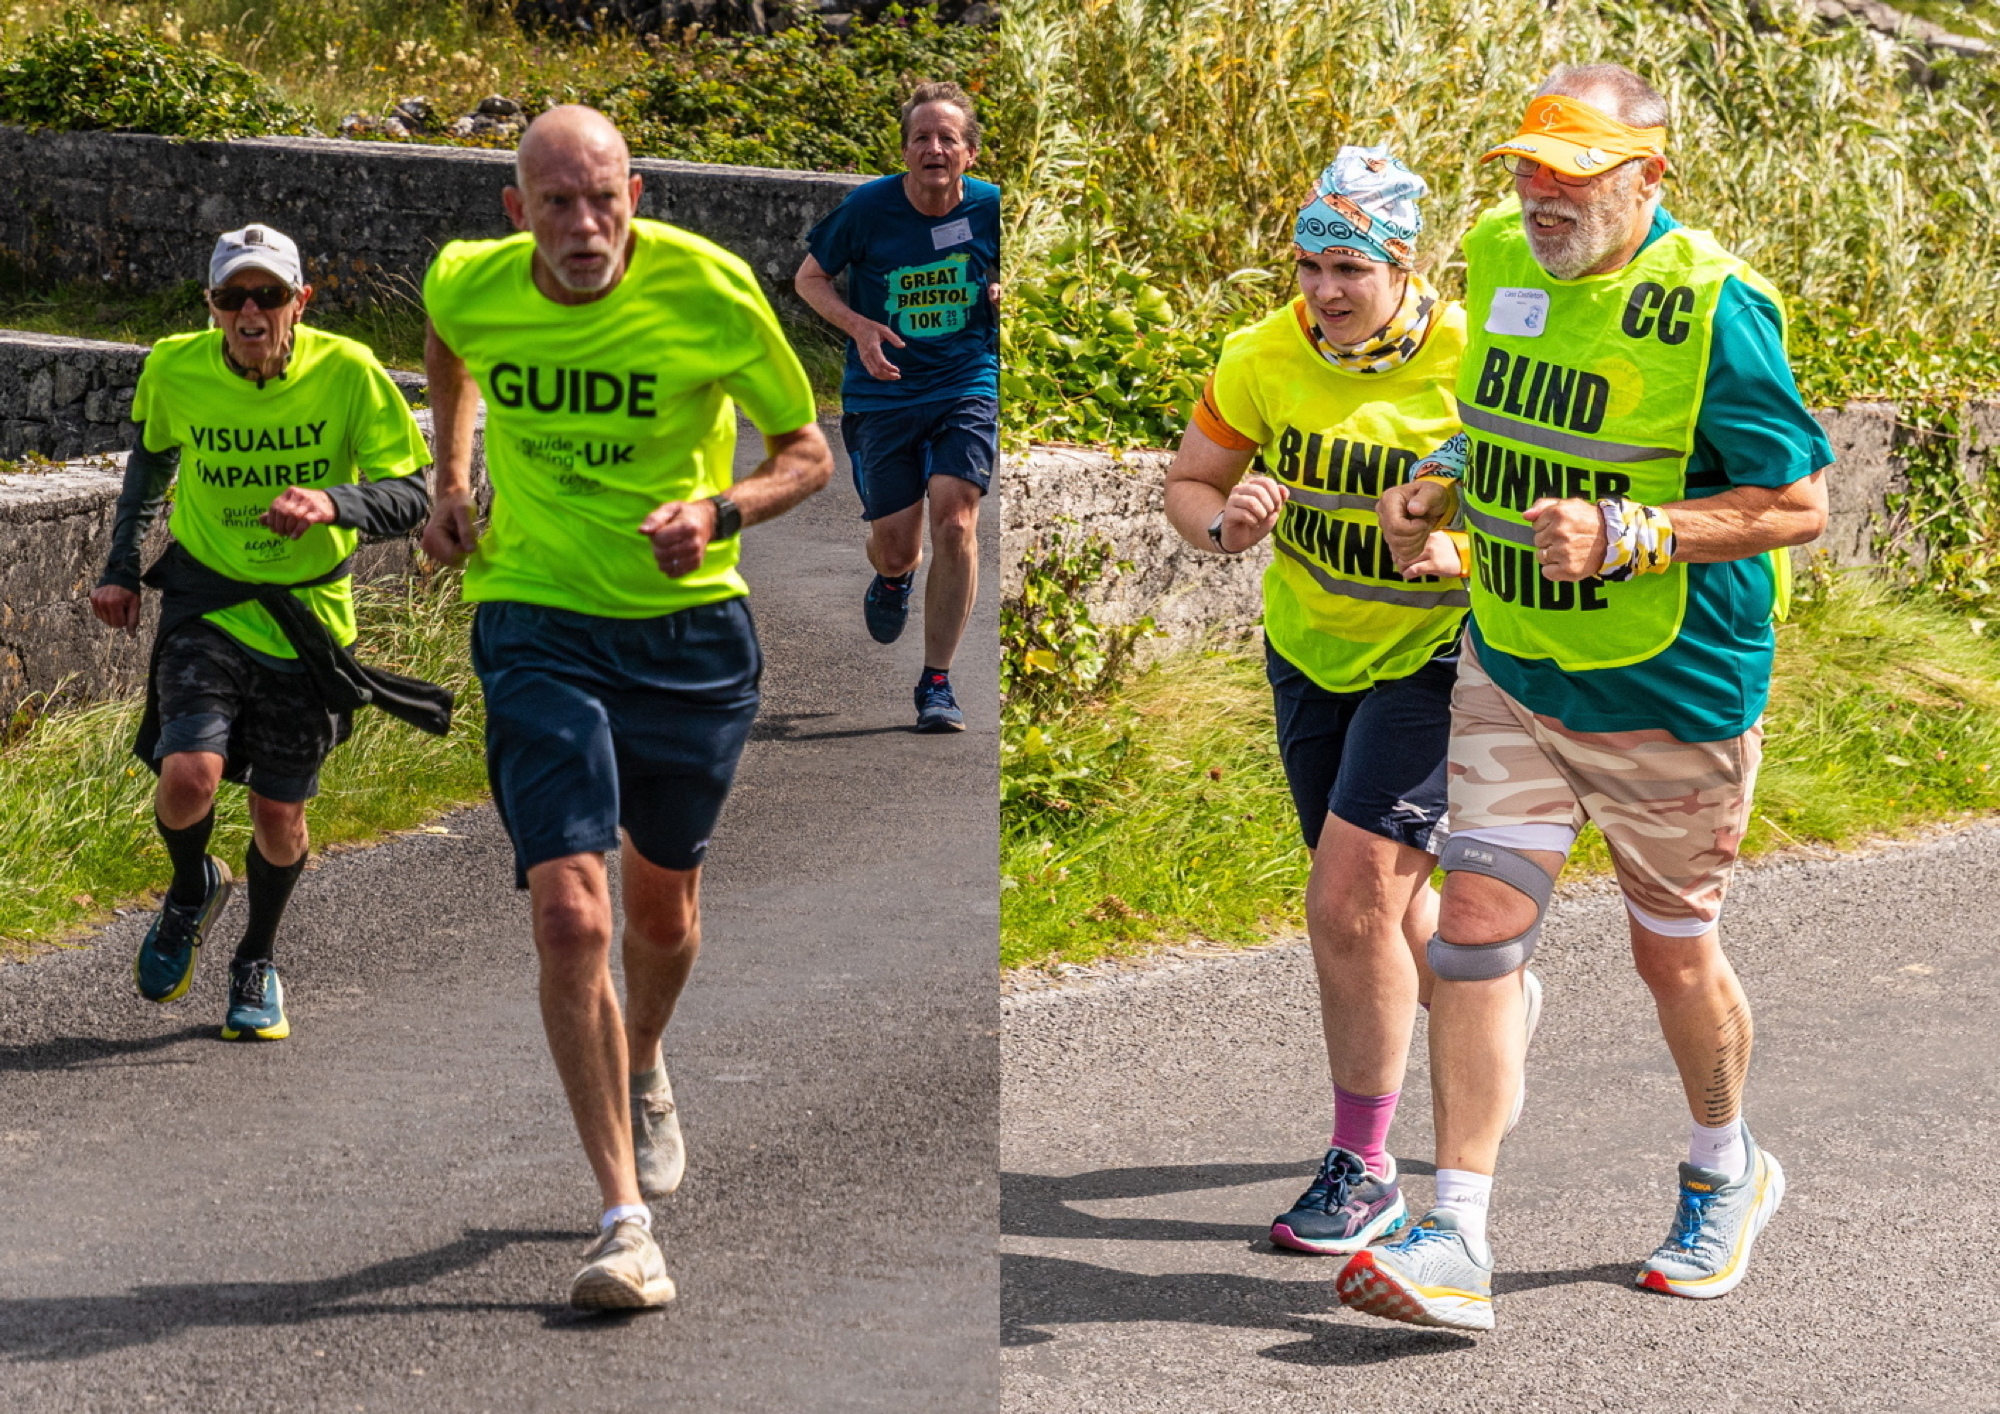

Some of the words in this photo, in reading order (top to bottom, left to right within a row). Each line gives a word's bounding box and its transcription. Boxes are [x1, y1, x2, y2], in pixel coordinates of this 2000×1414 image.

[900, 267, 959, 290] GREAT
[897, 286, 969, 309] BRISTOL
[908, 310, 942, 331] 10K
[1621, 280, 1696, 346] CC
[489, 362, 658, 418] GUIDE
[1474, 346, 1610, 434] BLIND
[190, 420, 328, 451] VISUALLY
[196, 458, 330, 488] IMPAIRED
[1277, 424, 1420, 497] BLIND
[1686, 1180, 1711, 1192] HOKA
